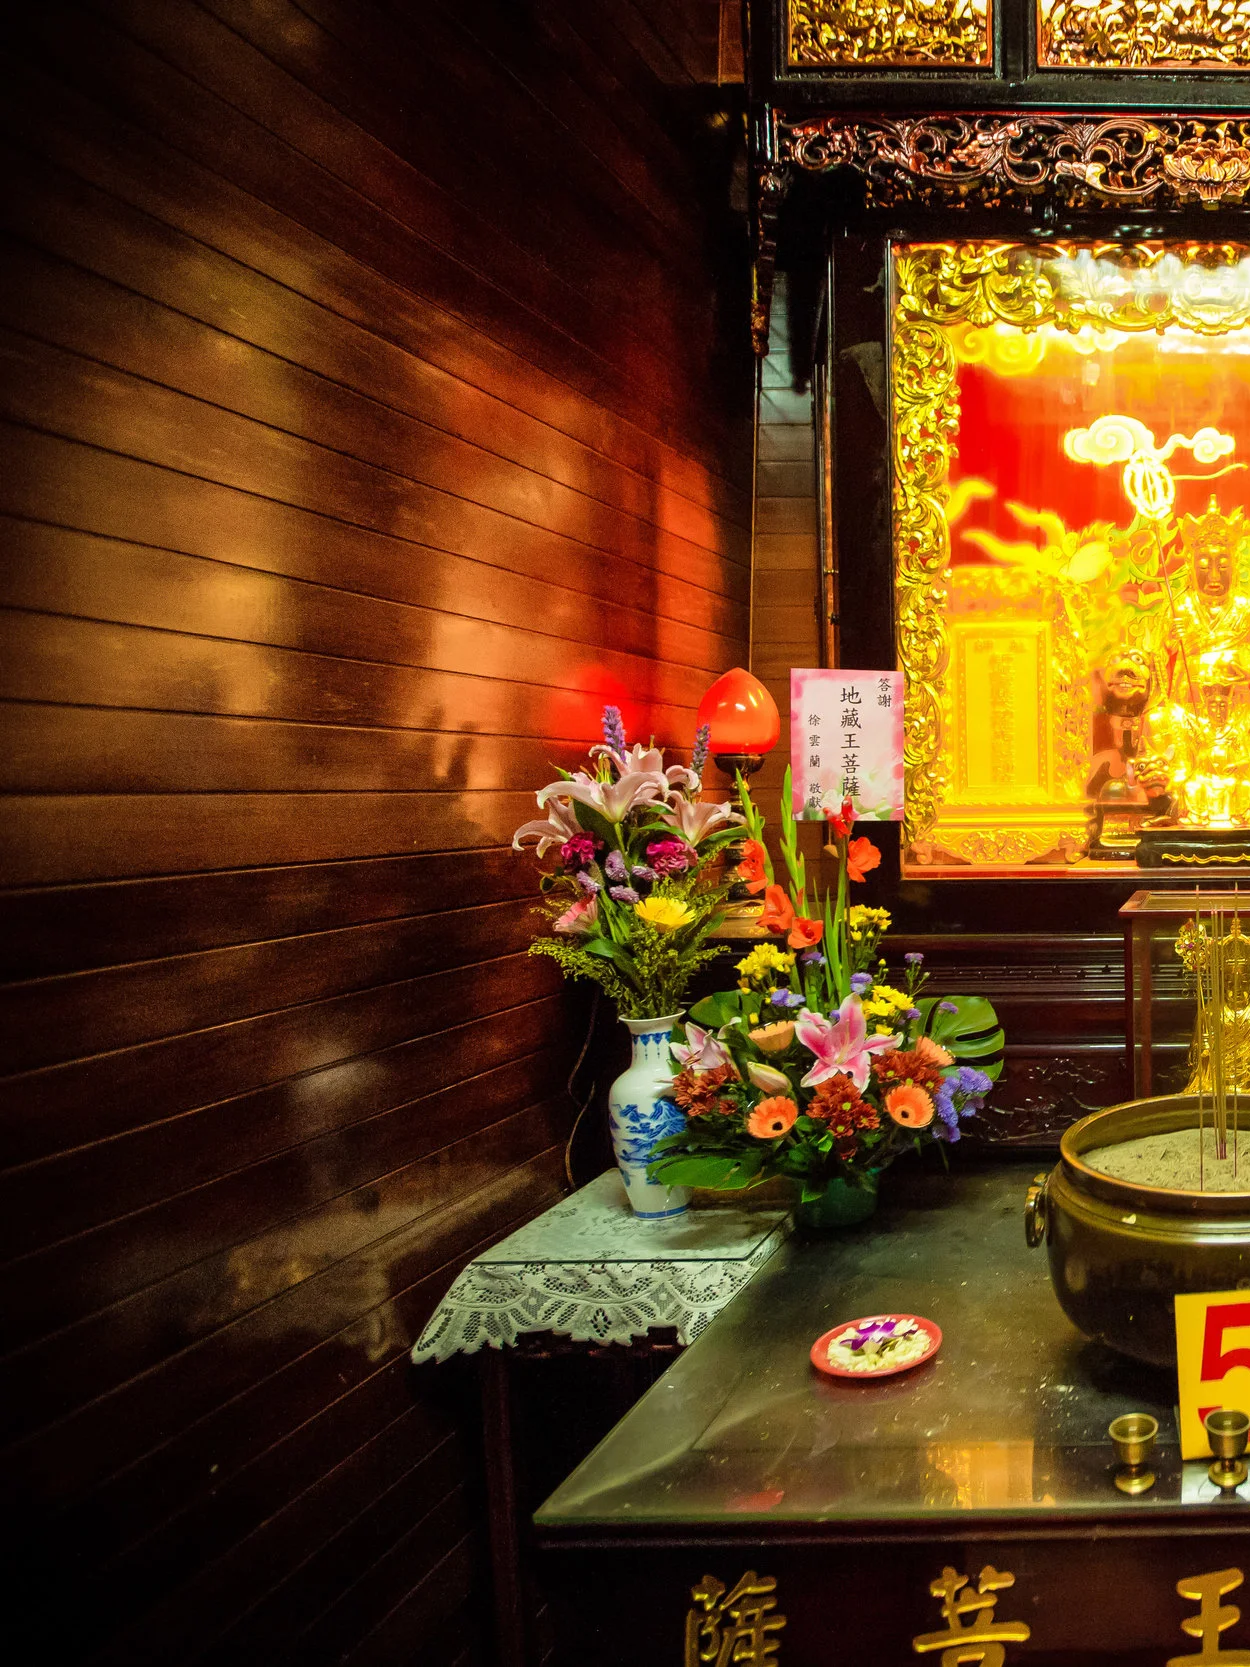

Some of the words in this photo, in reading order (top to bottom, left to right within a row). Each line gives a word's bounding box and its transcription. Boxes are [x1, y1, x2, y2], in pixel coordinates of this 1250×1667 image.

[876, 677, 892, 708] 答謝
[807, 713, 821, 768] 徐雲蘭
[839, 685, 862, 797] 地藏王菩薩
[808, 782, 822, 809] 敬獻
